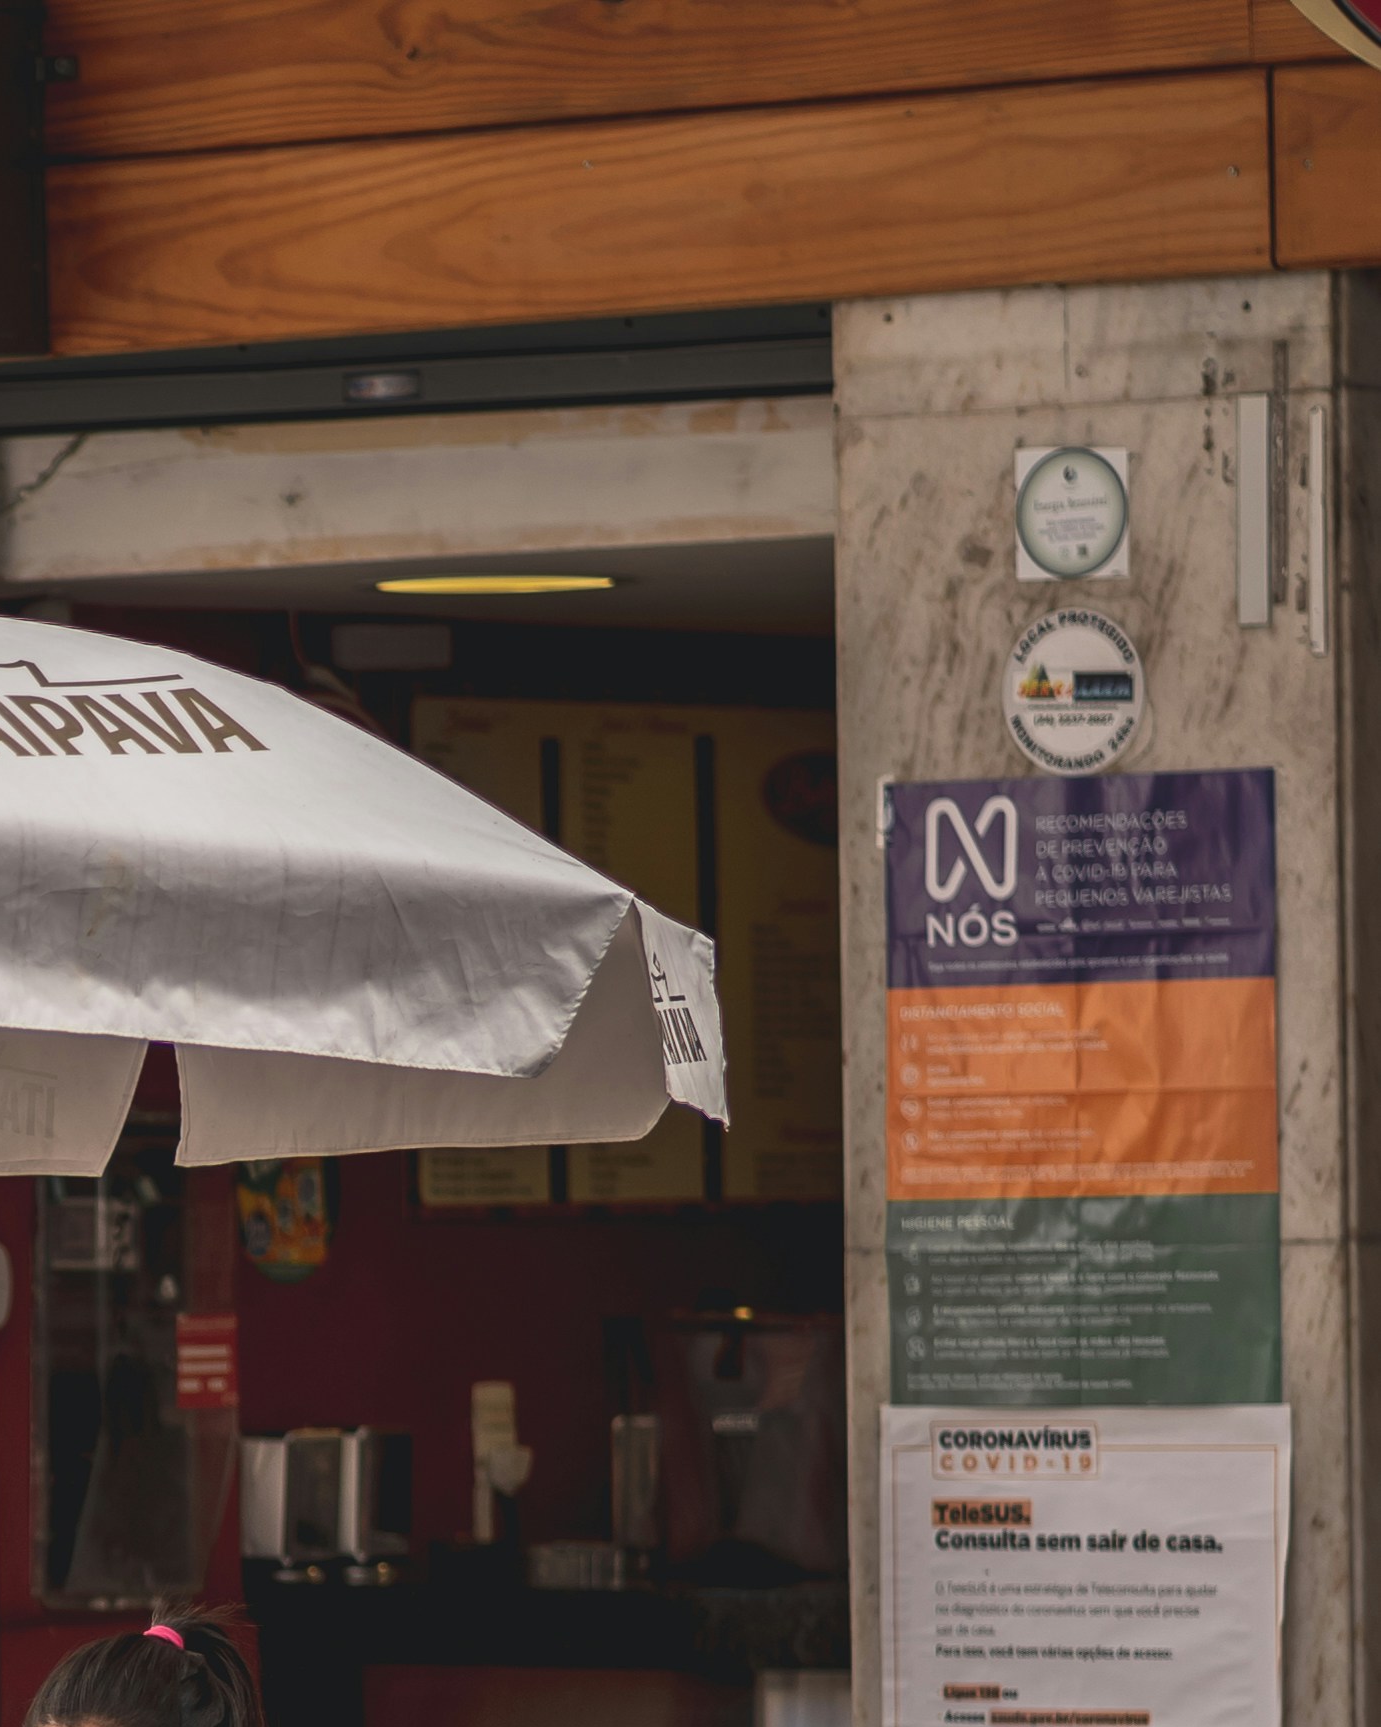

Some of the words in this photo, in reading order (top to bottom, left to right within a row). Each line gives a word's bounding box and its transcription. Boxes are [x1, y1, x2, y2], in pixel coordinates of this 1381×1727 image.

[1035, 840, 1058, 859] DE
[1131, 860, 1178, 880] PARA
[1035, 887, 1129, 908] PEQUENOS
[1132, 883, 1233, 905] VAREJISTAS
[926, 903, 1019, 948] NÓS
[938, 1425, 1092, 1450] CORONAVÍRUS
[934, 1503, 1031, 1525] TeleSUS.
[935, 1530, 1031, 1552] Consulta
[1036, 1536, 1081, 1552] sem
[1087, 1530, 1127, 1552] sair
[1132, 1532, 1160, 1553] de
[1166, 1536, 1223, 1553] casa.
